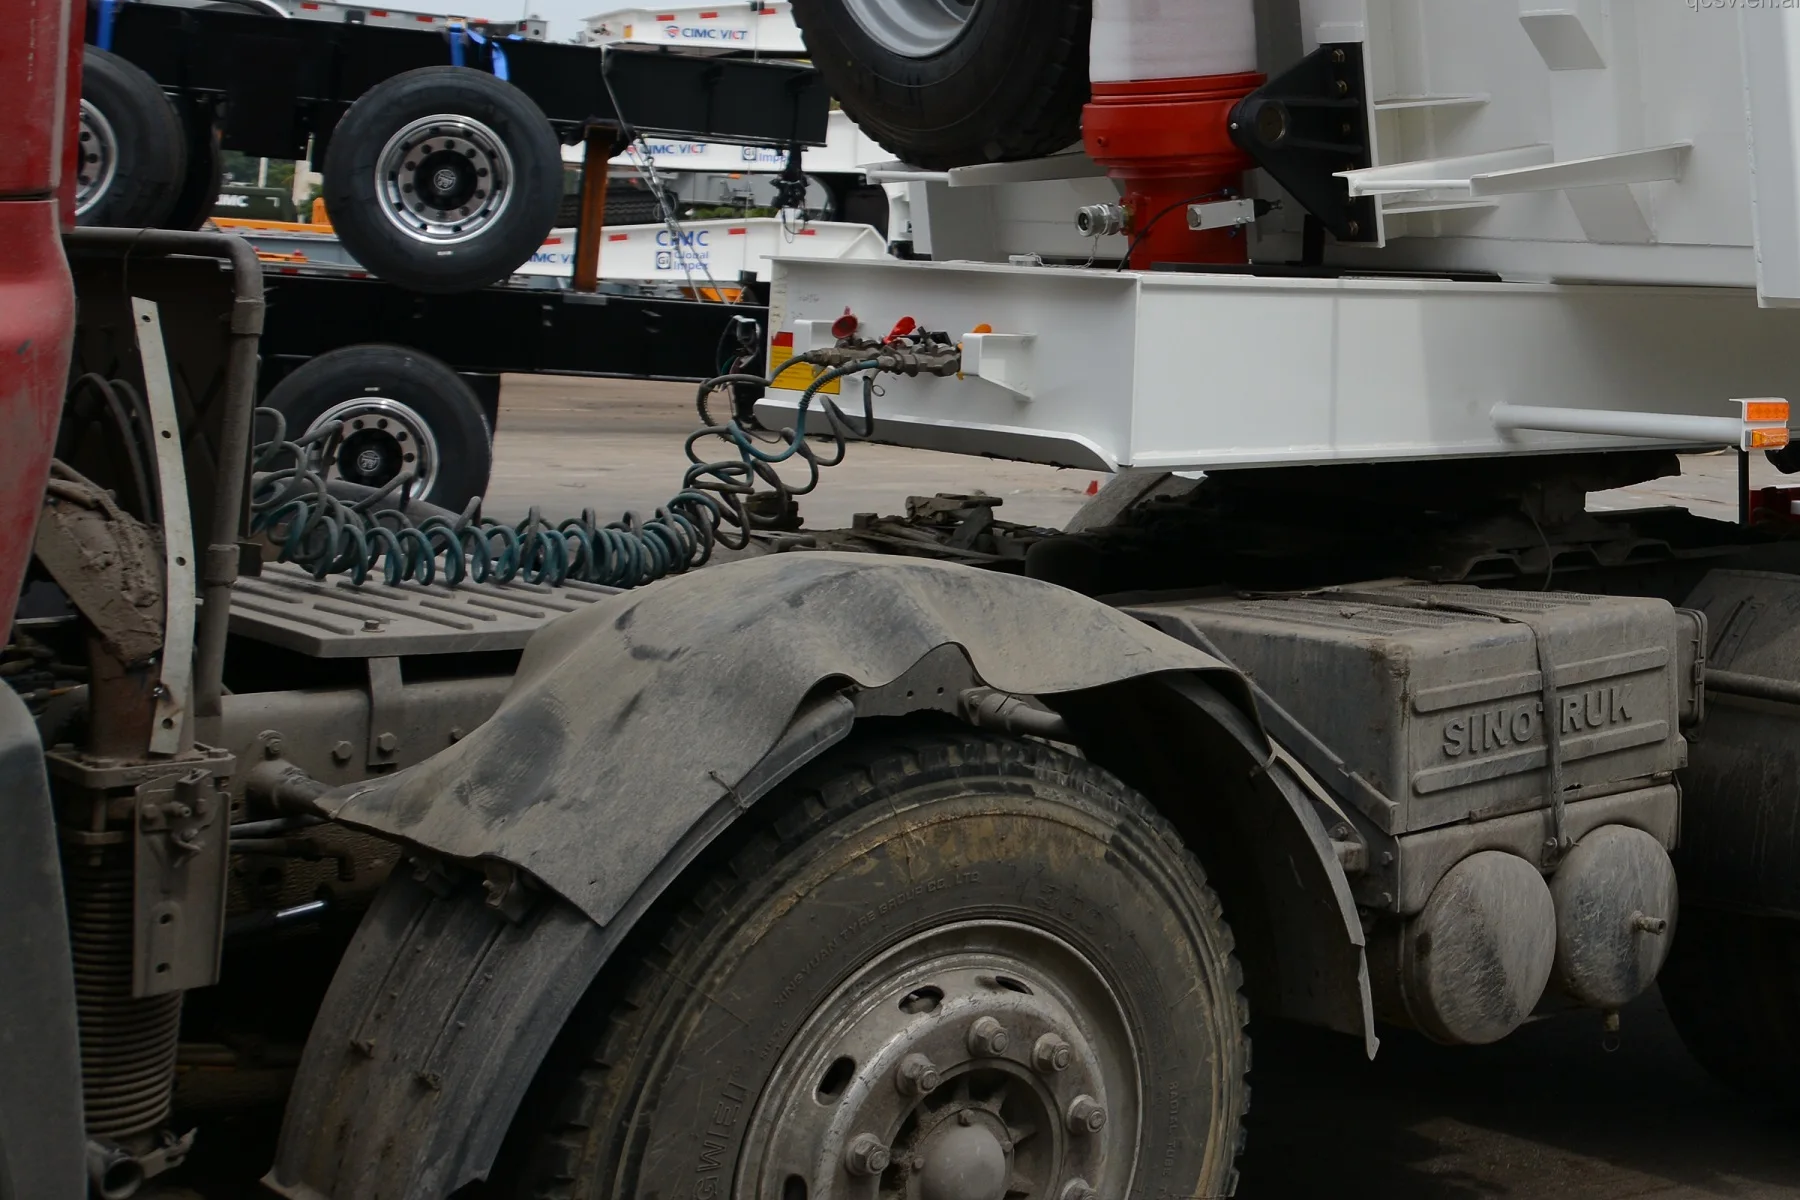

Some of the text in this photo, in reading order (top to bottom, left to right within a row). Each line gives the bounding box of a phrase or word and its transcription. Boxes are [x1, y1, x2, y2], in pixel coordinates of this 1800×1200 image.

[682, 27, 748, 40] CIMC VICT
[678, 143, 707, 154] VICT
[214, 193, 250, 208] IMC
[655, 229, 710, 247] CIMC
[1442, 683, 1633, 758] SINORUK
[774, 939, 837, 1007] XINGYUAN
[840, 909, 876, 939] TYRE
[878, 887, 922, 917] GROUP
